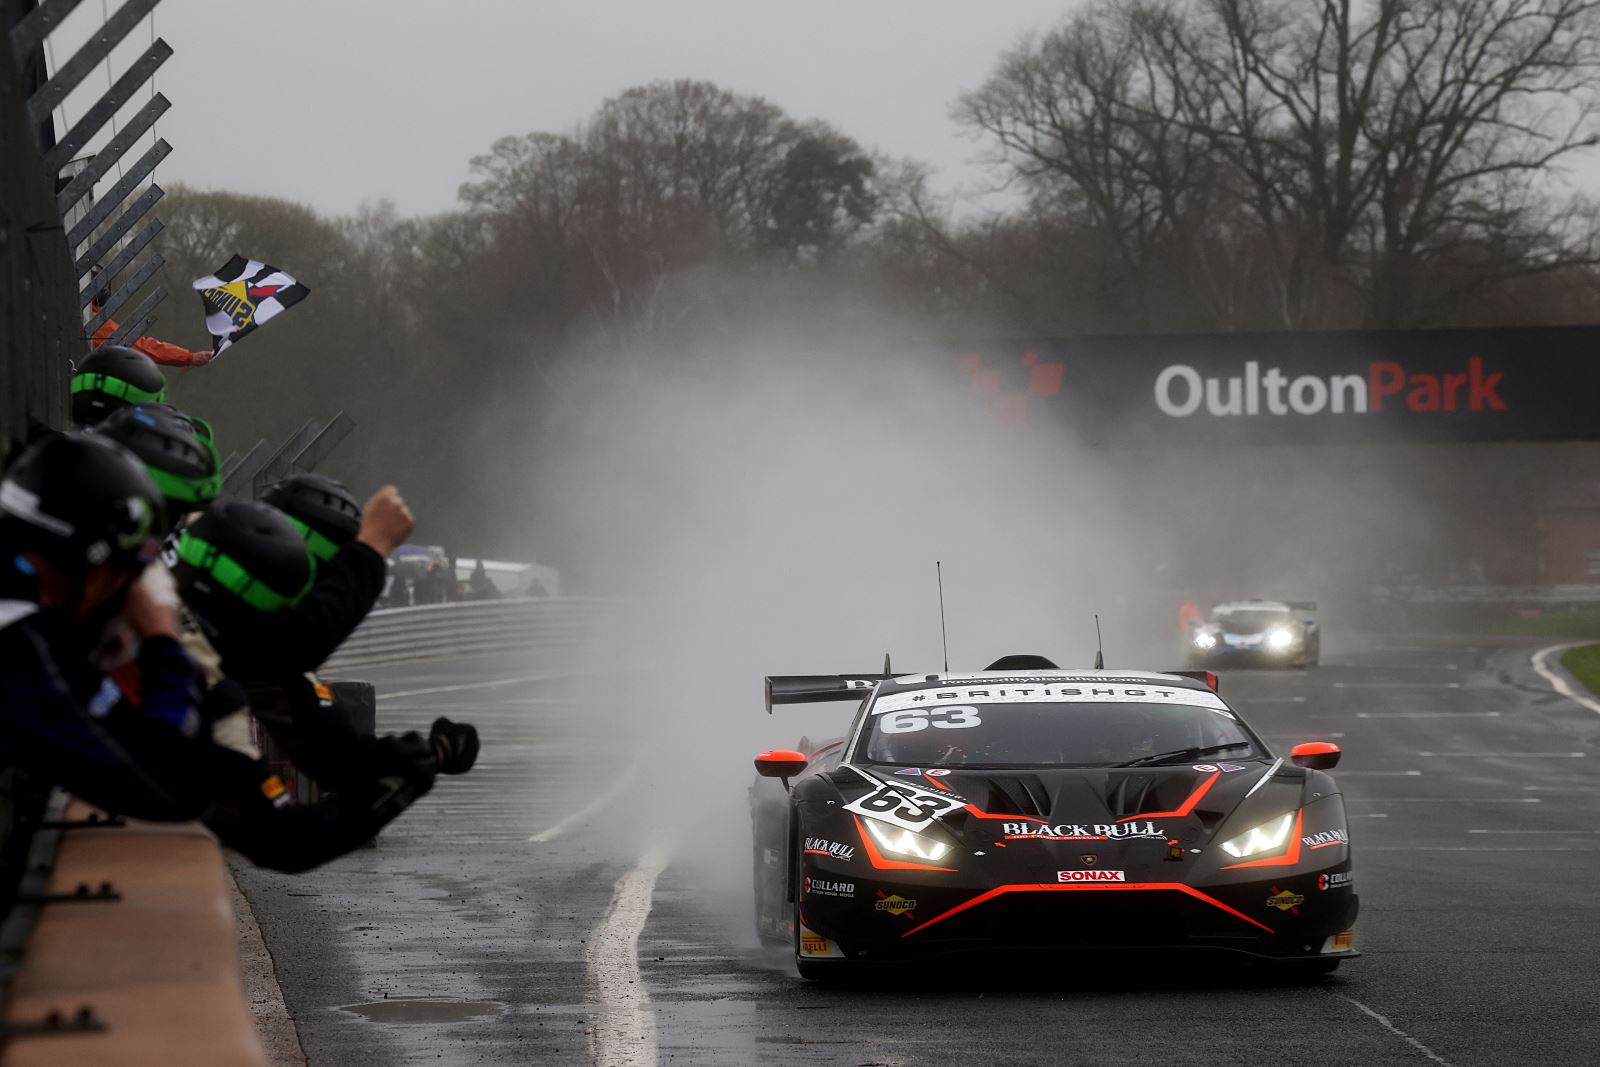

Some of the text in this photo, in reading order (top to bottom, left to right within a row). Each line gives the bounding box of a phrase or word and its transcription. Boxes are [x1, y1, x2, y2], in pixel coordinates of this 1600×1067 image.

[912, 688, 1175, 702] #BRITISHGT
[880, 705, 982, 734] 63
[859, 784, 952, 822] 63
[1003, 821, 1167, 840] BLACK BULL
[804, 838, 855, 859] BLACK BULL
[1060, 872, 1120, 880] SONAX
[812, 879, 855, 893] COLLARD
[877, 900, 914, 909] SUNOCO
